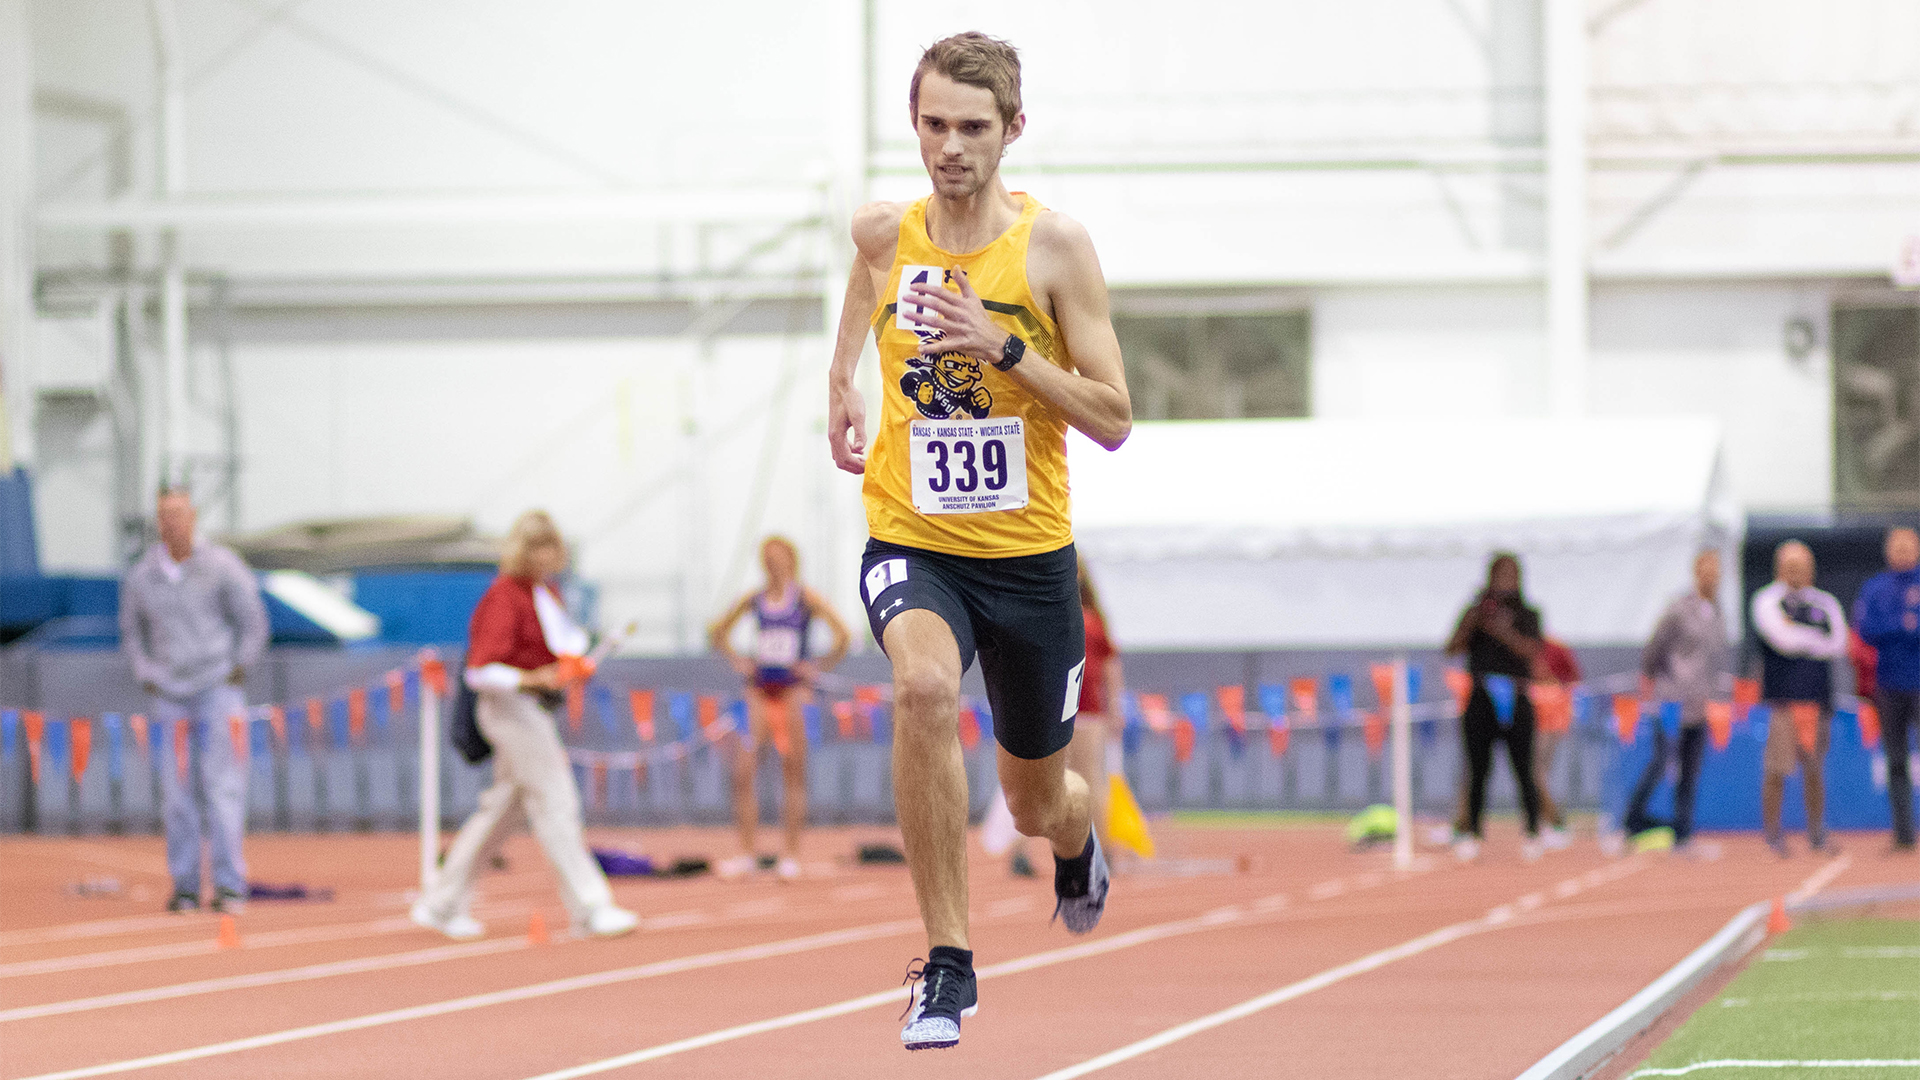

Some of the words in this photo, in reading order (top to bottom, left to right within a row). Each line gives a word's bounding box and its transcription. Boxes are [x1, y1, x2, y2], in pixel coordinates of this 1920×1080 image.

[935, 390, 955, 413] WSU
[912, 426, 931, 437] KANSAS
[937, 427, 957, 437] KANSAS
[958, 427, 973, 437] STATE
[980, 425, 1003, 436] WICHITA
[1004, 424, 1020, 435] STATE
[926, 439, 1008, 493] 339
[977, 494, 1000, 502] KANSAS
[971, 501, 996, 509] PAVILION
